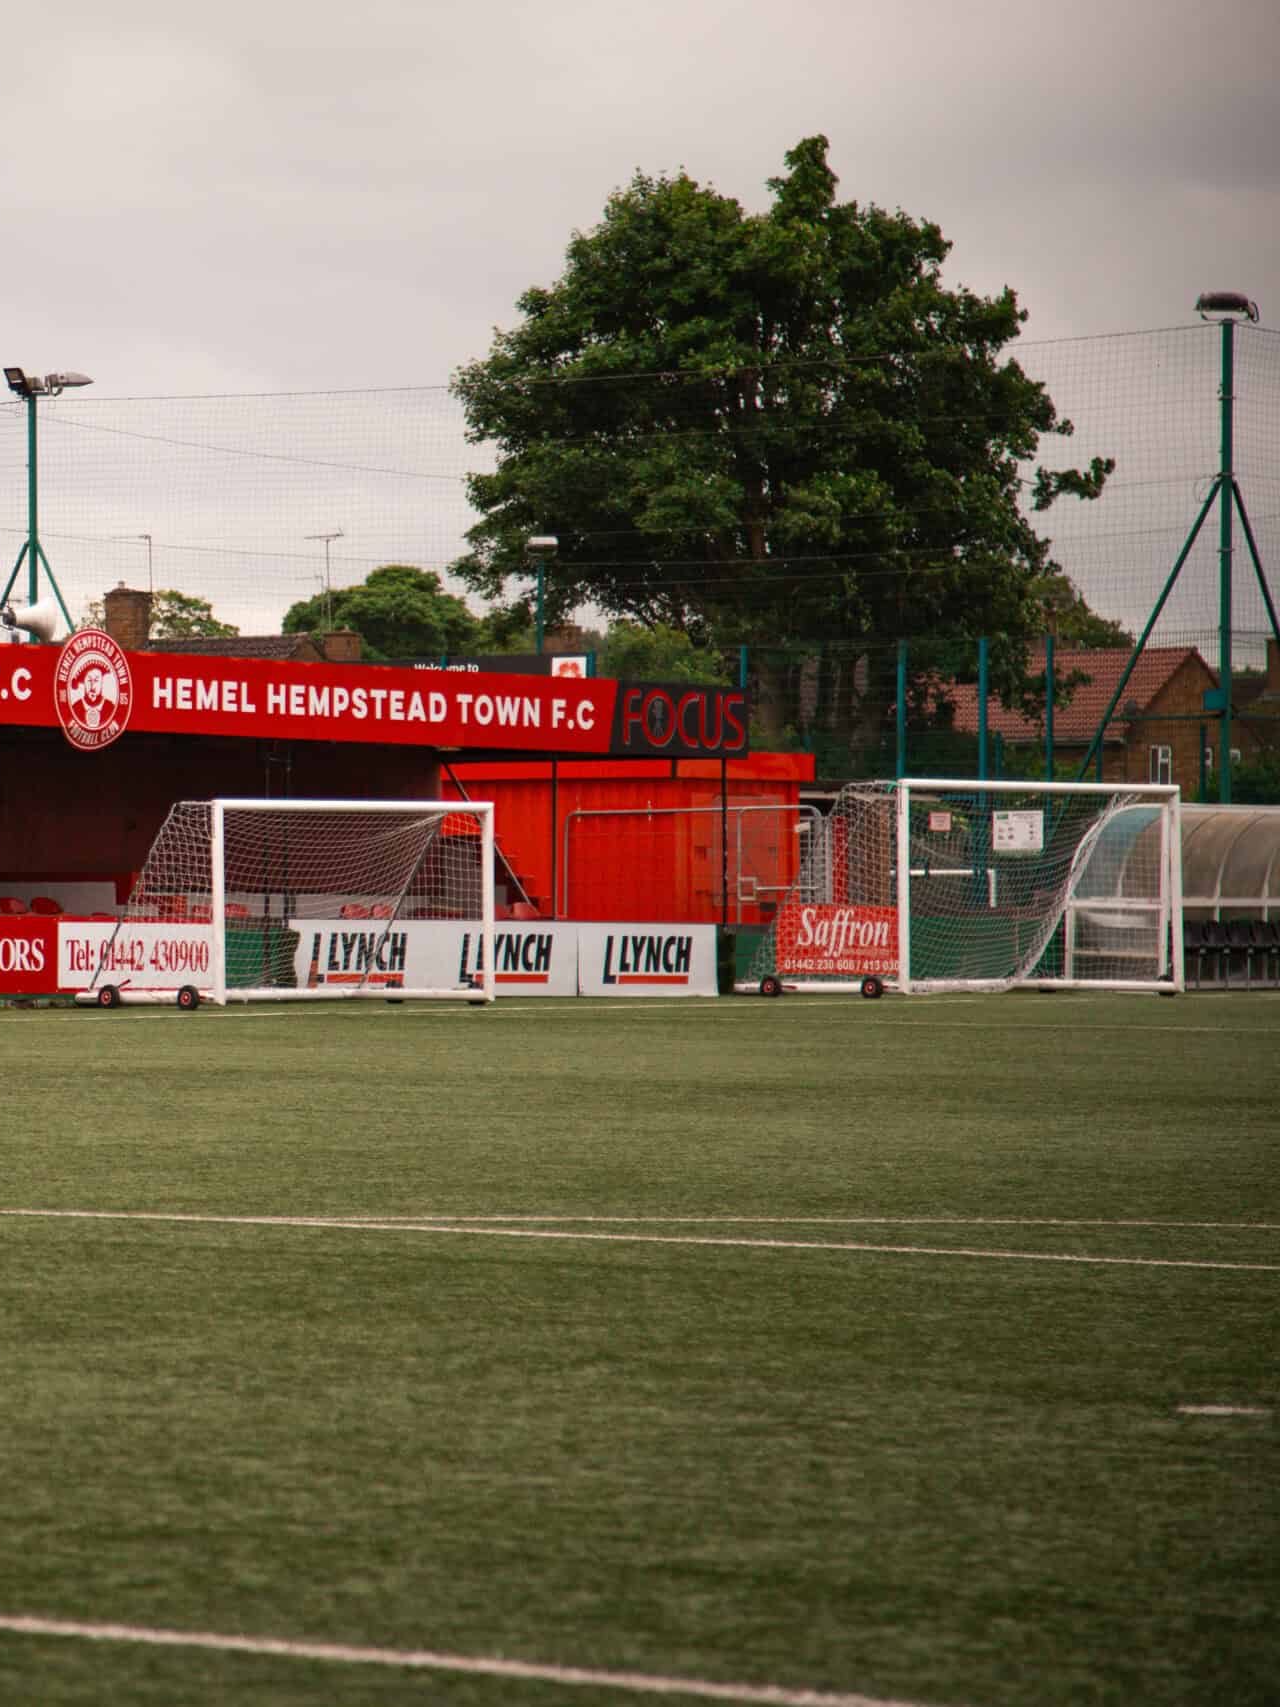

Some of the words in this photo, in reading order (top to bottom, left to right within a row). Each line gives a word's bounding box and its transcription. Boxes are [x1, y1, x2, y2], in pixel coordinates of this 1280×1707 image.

[153, 677, 256, 713] HEMEL
[267, 683, 447, 722] HEMPSTEAD
[456, 693, 540, 728] TOWN
[552, 698, 595, 730] F.C
[623, 688, 745, 750] FOCUS
[327, 932, 408, 971] LYNCH
[619, 936, 692, 972] LYNCH
[798, 908, 889, 957] Saffron
[66, 939, 95, 972] Tel:
[100, 939, 144, 972] 01442
[149, 939, 209, 973] 430900
